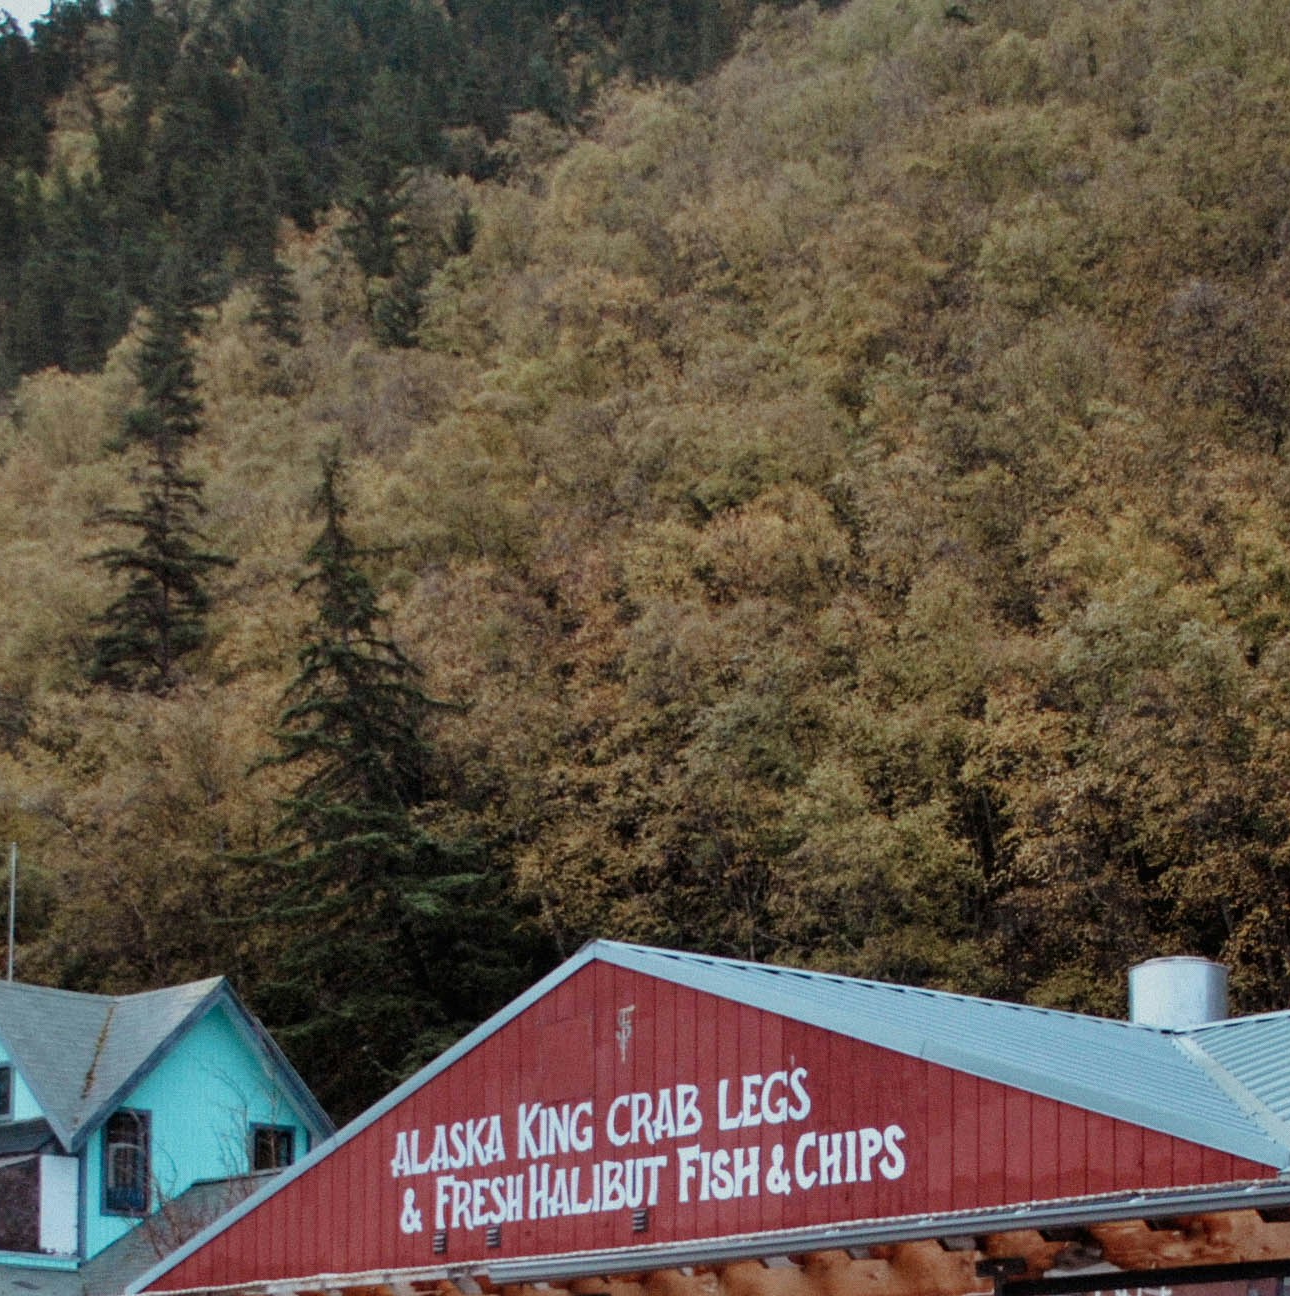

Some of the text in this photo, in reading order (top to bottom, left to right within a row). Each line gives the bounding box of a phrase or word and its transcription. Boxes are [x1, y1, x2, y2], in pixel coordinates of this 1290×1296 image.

[390, 1067, 811, 1178] ALASKA KING CRAB LEGS
[400, 1124, 906, 1234] & FRESH HALIBUT FISH & CHIPS
